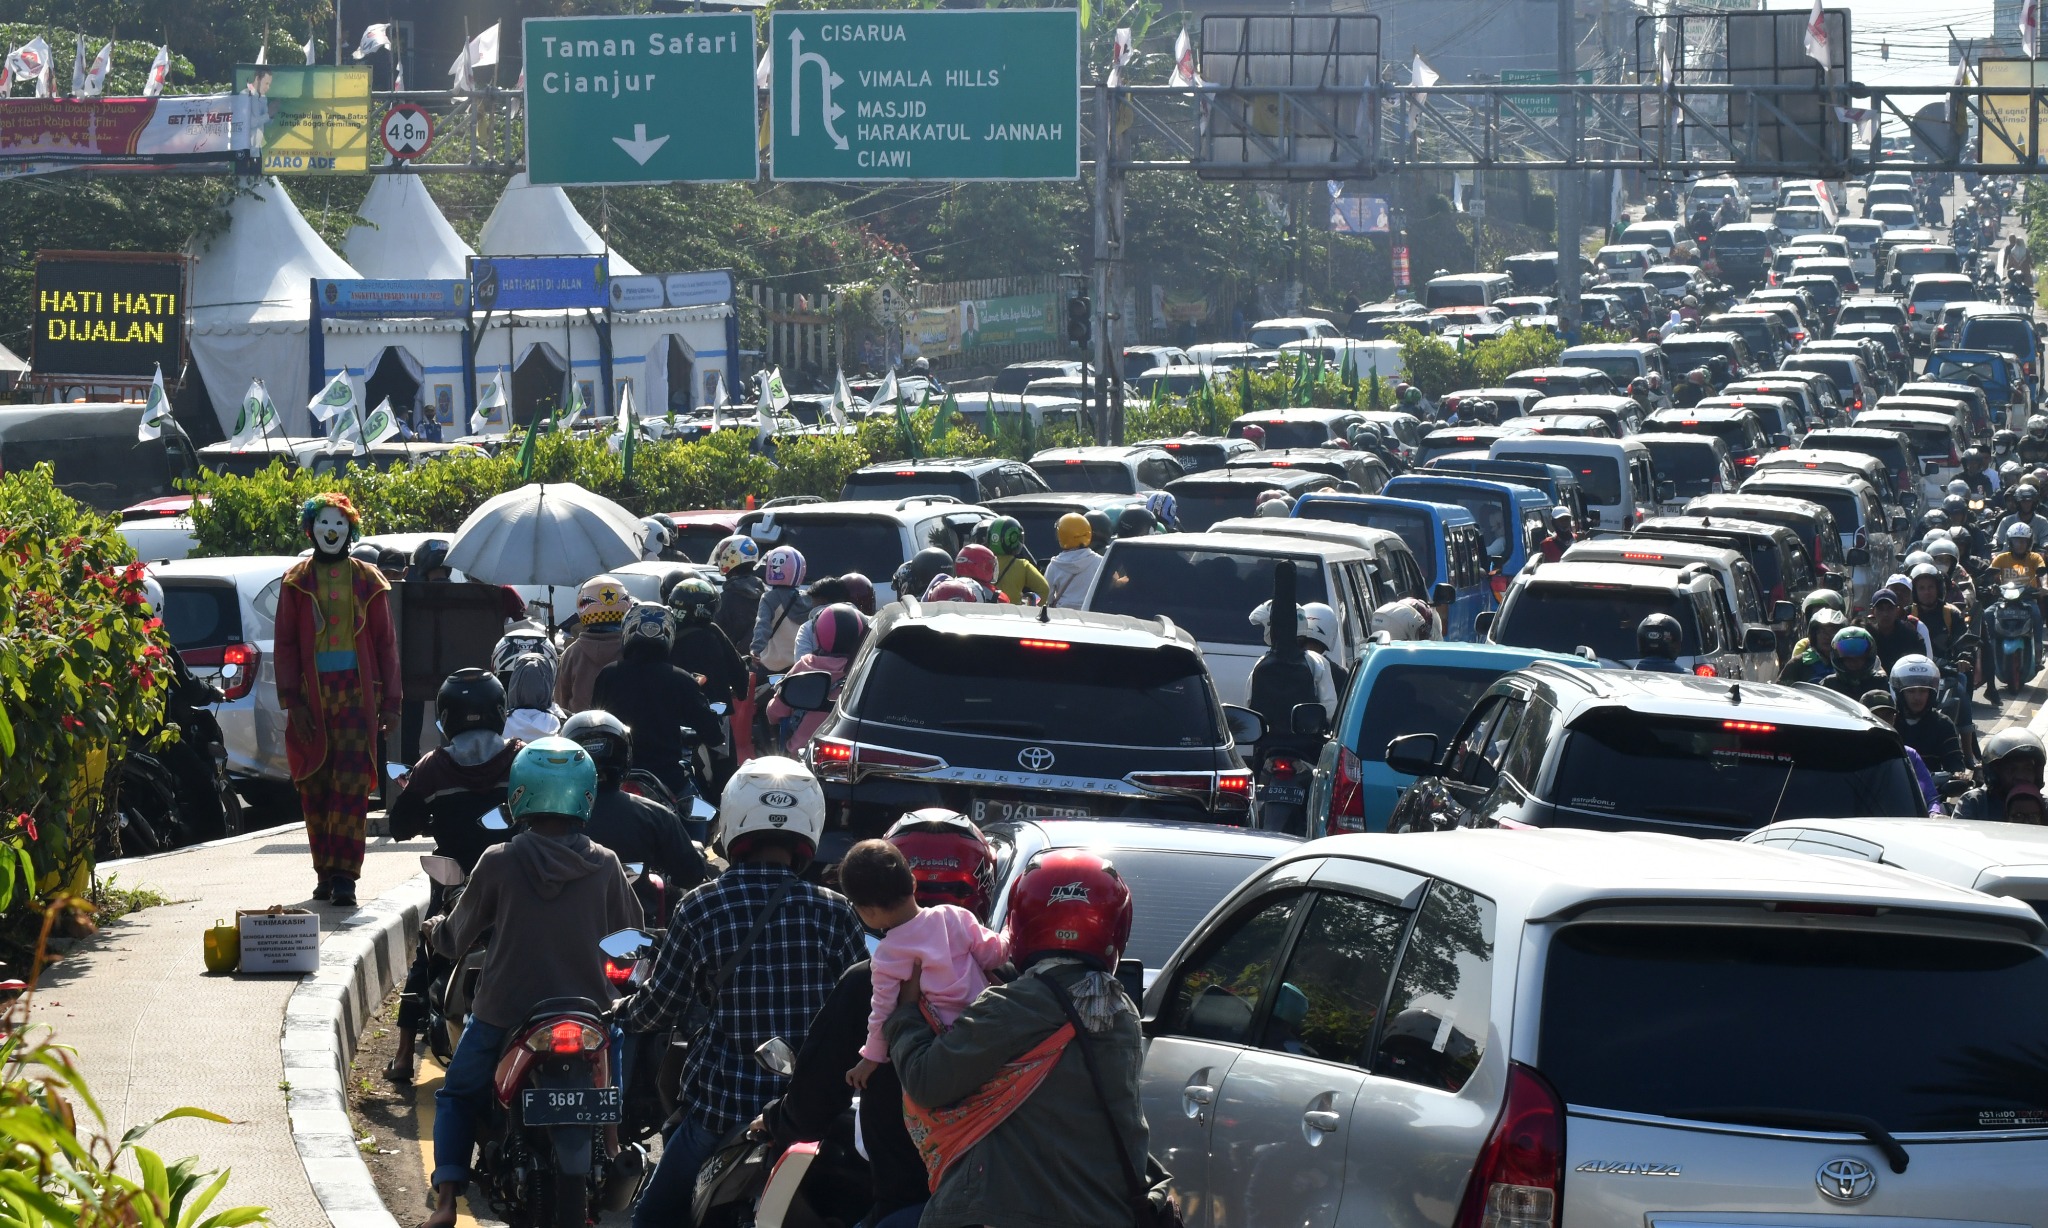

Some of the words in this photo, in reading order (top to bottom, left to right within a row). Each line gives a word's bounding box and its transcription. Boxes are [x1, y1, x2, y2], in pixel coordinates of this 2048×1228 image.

[821, 25, 907, 42] CISARUA
[541, 36, 636, 58] Taman
[648, 31, 737, 56] Safari
[542, 70, 656, 99] Cianjur
[858, 70, 932, 87] VIMALA
[857, 101, 927, 118] MASJID
[168, 114, 186, 125] GET
[187, 113, 205, 124] THE
[206, 112, 233, 124] TASTE
[857, 123, 971, 141] HARAKATUL
[984, 123, 1063, 141] JANNAH
[265, 156, 303, 168] JARO
[308, 156, 336, 169] ADE
[857, 151, 912, 167] CIAWI
[546, 279, 554, 290] DI
[556, 278, 582, 290] JALAN
[40, 290, 102, 313] HATI
[113, 292, 175, 315] HATI
[48, 319, 163, 343] DIJALAN
[951, 770, 1118, 790] FORTUNER
[975, 802, 986, 821] B
[253, 918, 306, 926] TERIMAKASIH
[1057, 930, 1076, 938] DOT
[525, 1093, 534, 1108] F
[548, 1092, 585, 1107] 3687
[599, 1091, 618, 1106] XE
[1575, 1159, 1683, 1176] AVANZA
